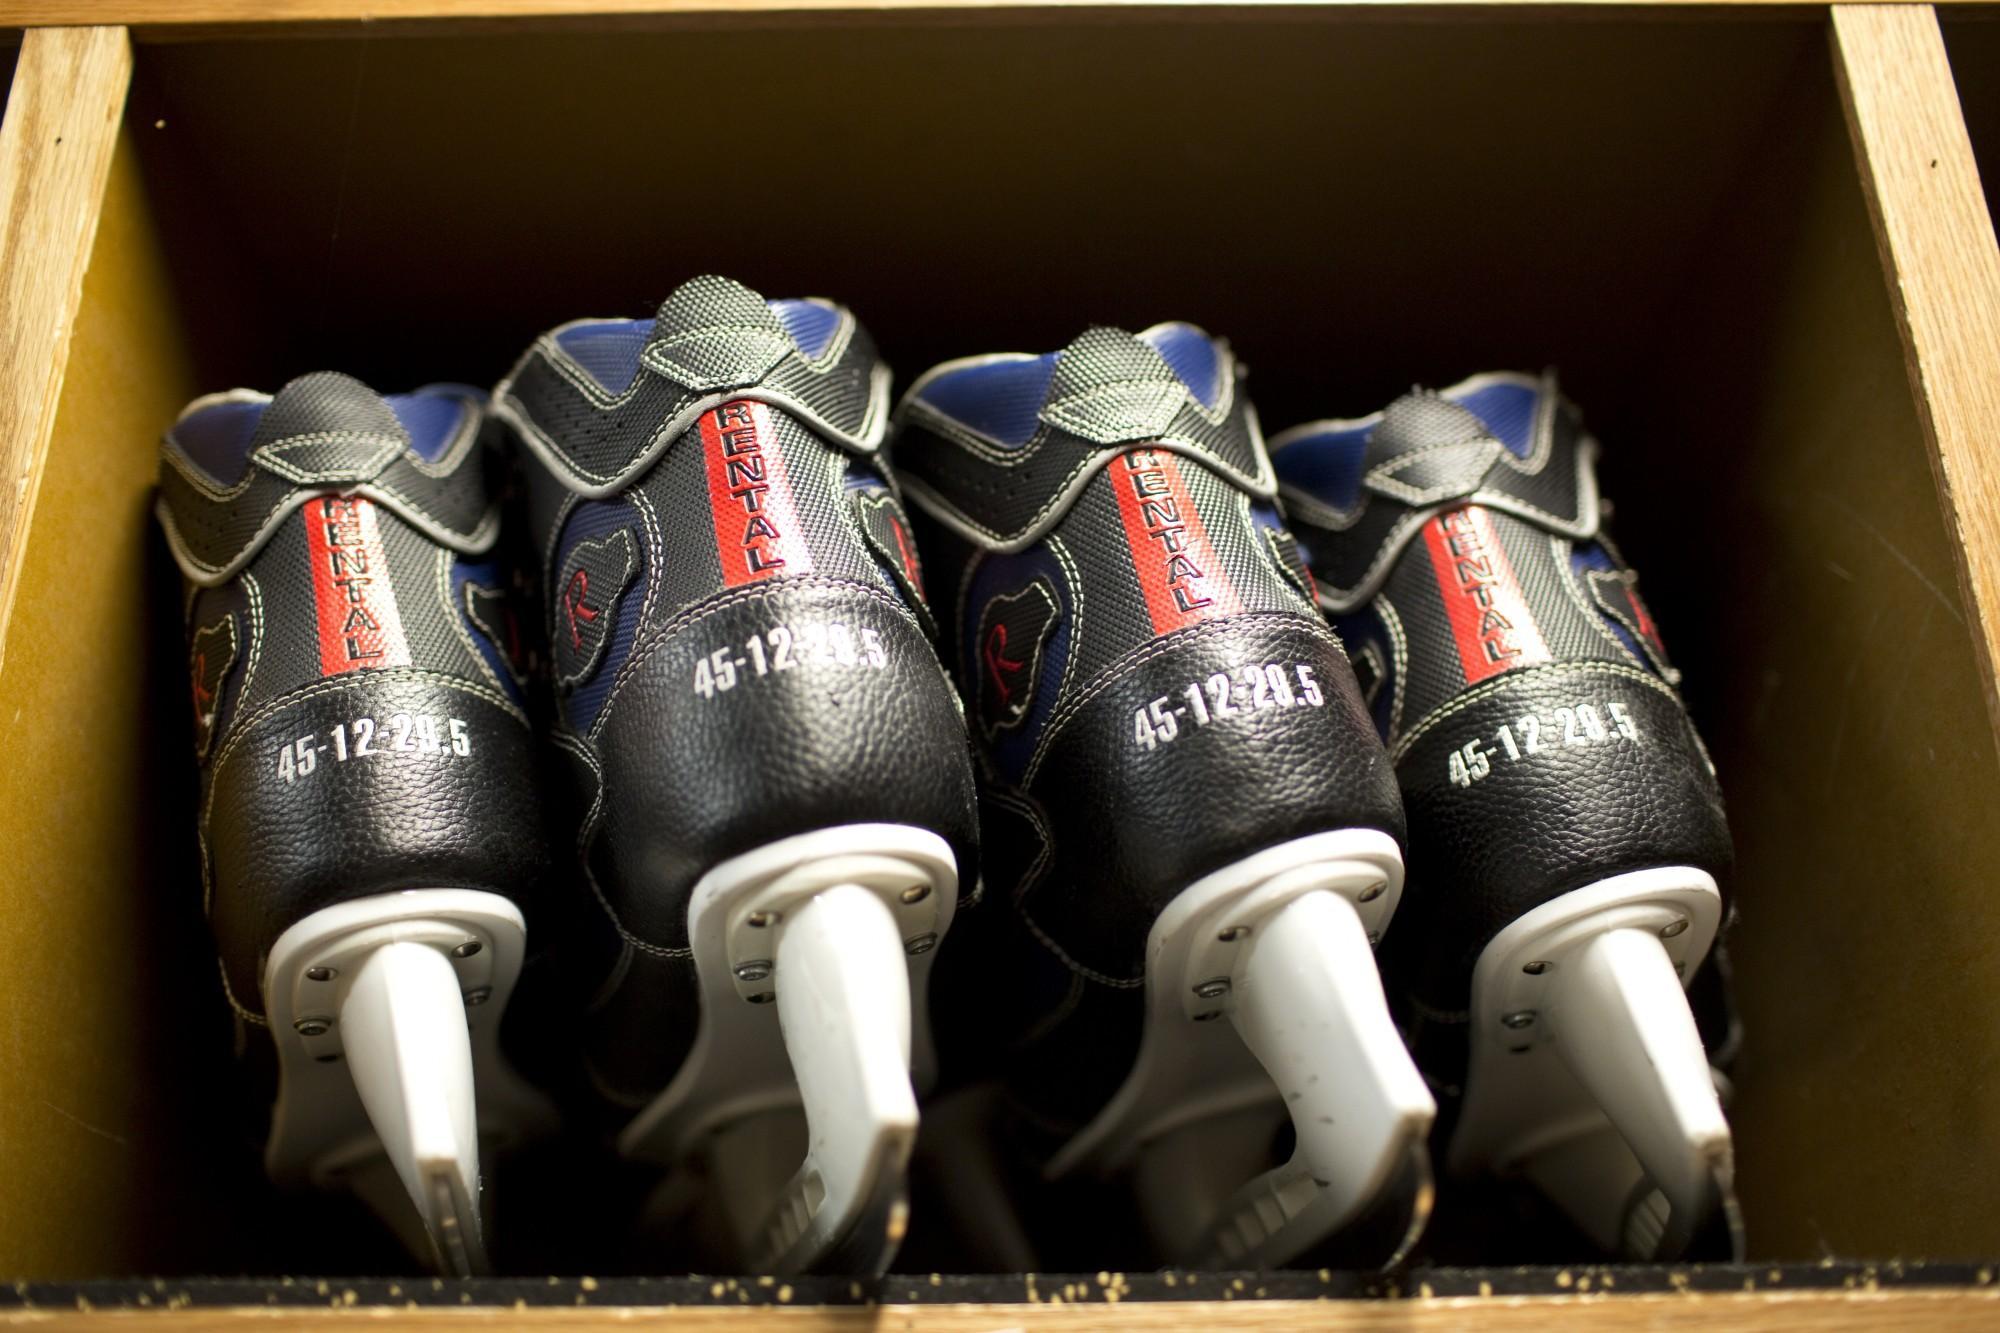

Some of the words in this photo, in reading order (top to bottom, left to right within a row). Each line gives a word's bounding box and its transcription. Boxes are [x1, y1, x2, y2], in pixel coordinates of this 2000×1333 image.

[715, 401, 785, 575] RENTAL
[277, 714, 472, 784] 45-12-29.5
[1133, 663, 1325, 751] 45-12-29.5
